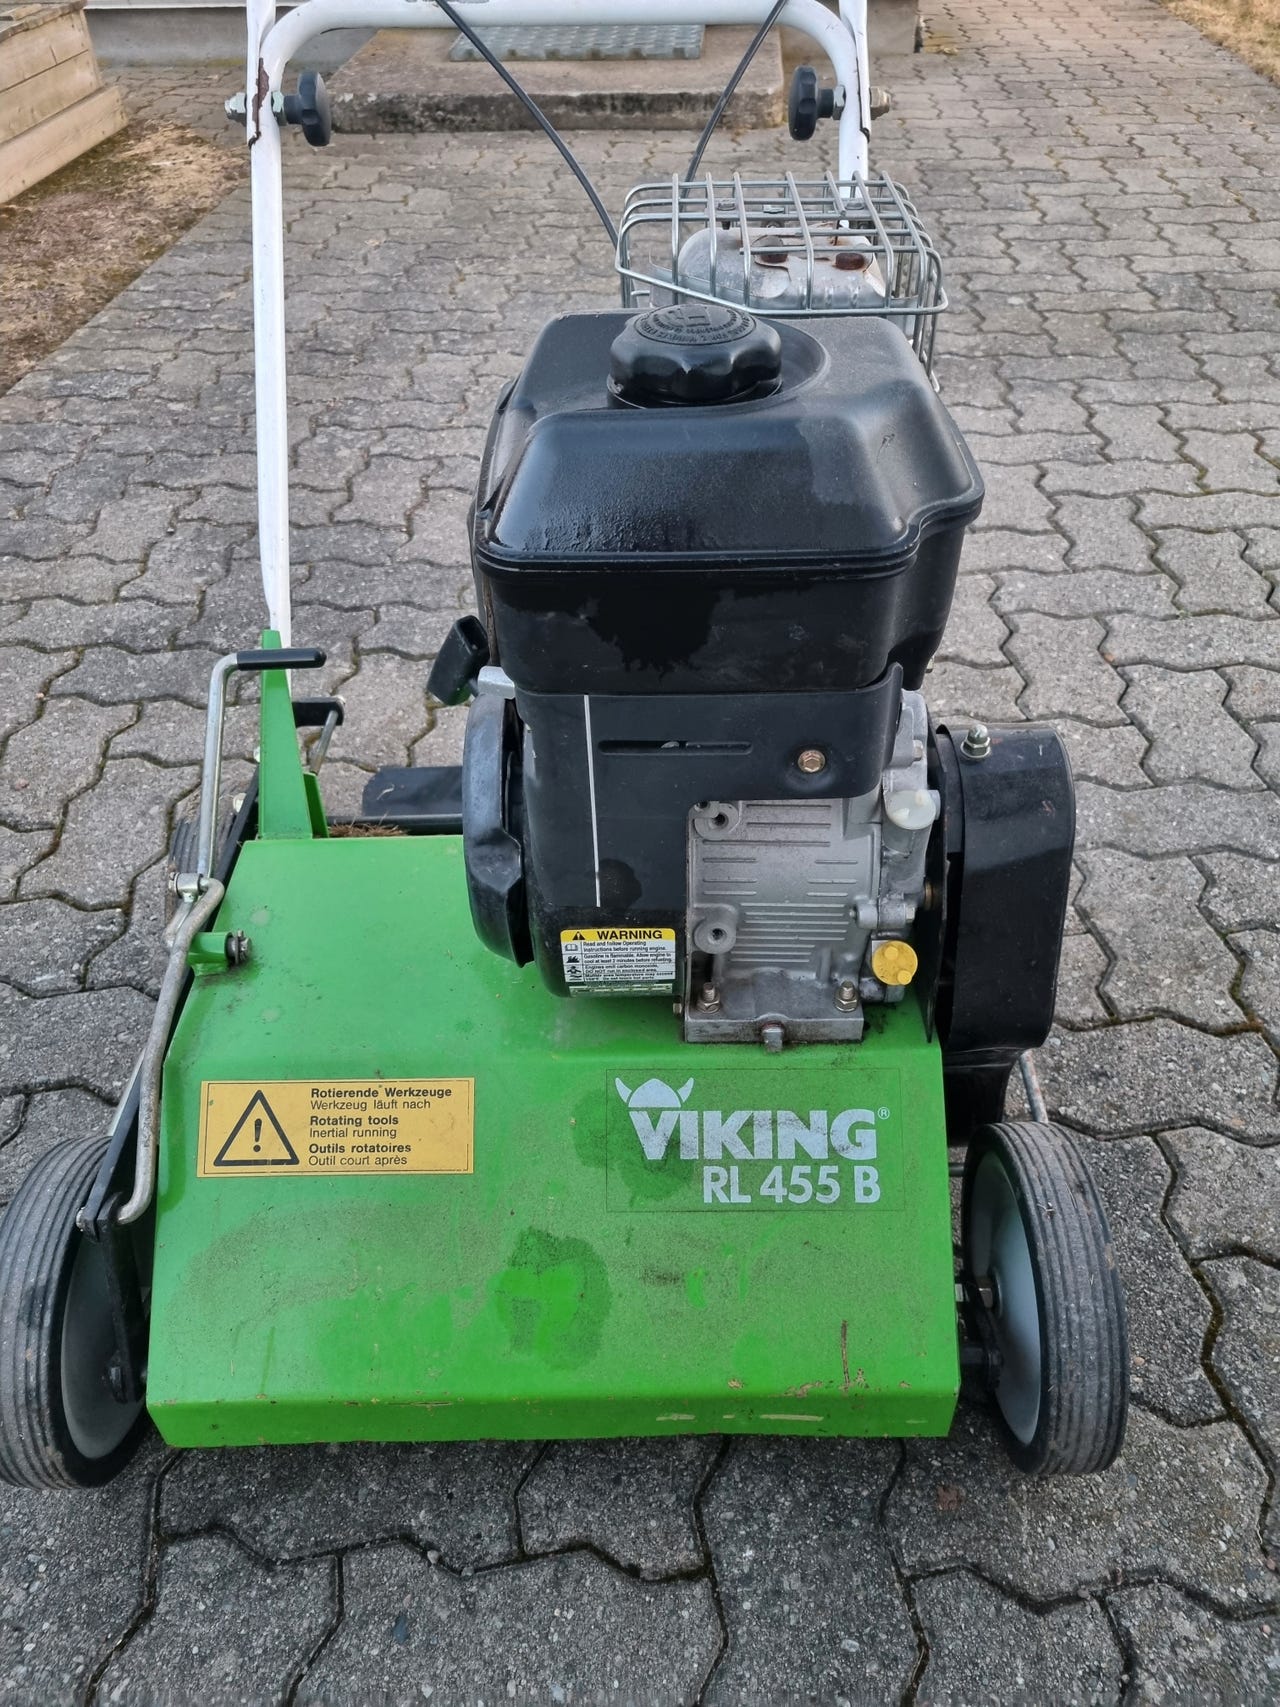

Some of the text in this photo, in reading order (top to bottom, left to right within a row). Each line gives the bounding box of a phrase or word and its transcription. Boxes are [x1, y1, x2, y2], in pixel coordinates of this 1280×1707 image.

[597, 930, 663, 940] WARNING
[311, 1087, 452, 1098] Rotierende Werkzeuge
[311, 1099, 431, 1111] Werkzeug läuft nach
[310, 1115, 399, 1127] Rotating tools
[309, 1127, 397, 1139] Inertial running
[309, 1143, 411, 1154] Outils rotatoires
[308, 1154, 408, 1167] Outil court après
[703, 1165, 881, 1204] RL 455 B
